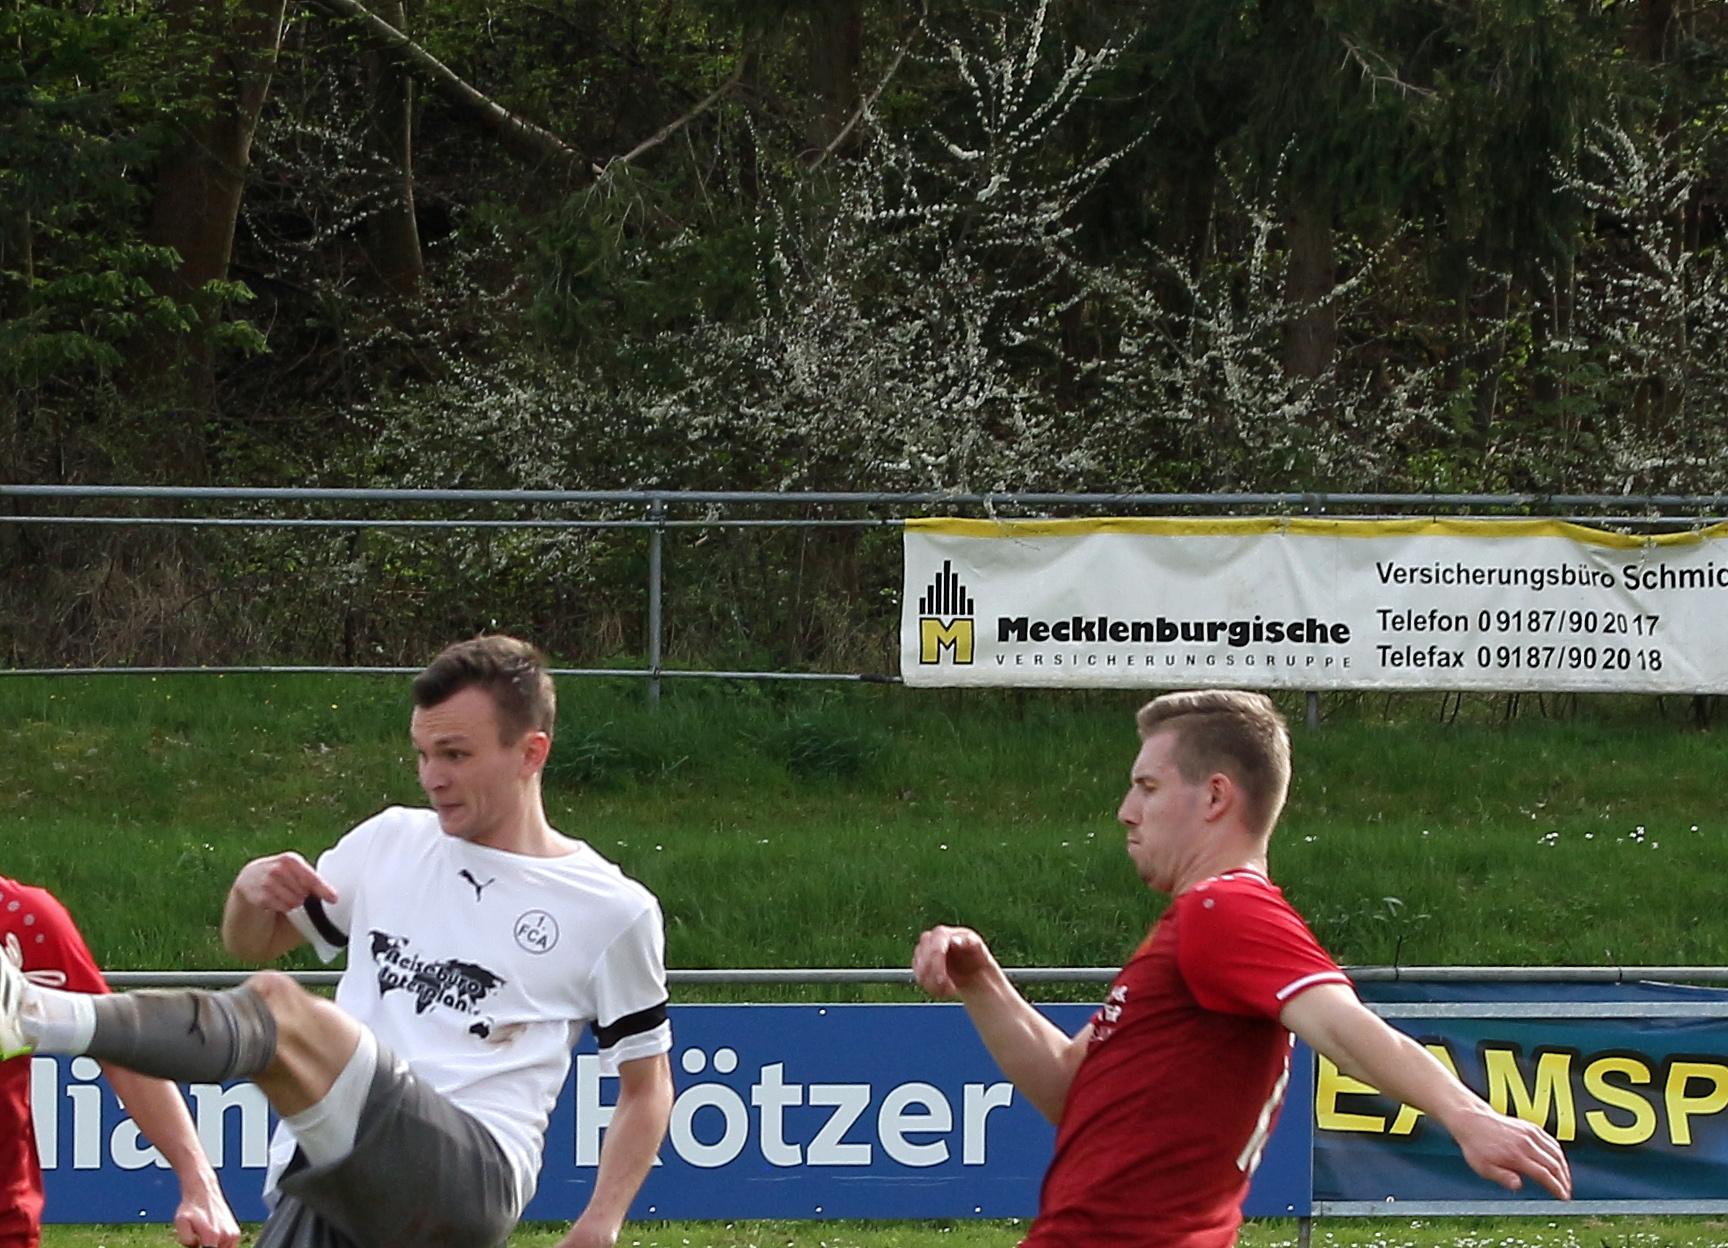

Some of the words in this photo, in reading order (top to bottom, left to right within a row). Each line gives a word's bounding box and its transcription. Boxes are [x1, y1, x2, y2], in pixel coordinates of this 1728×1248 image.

[1376, 562, 1615, 591] Versicherungsbüro
[997, 615, 1351, 647] Mecklenburgische
[1376, 609, 1469, 632] Telefon
[995, 654, 1352, 668] VERSICHERUNGSGRUPPE
[1376, 645, 1465, 668] Telefax
